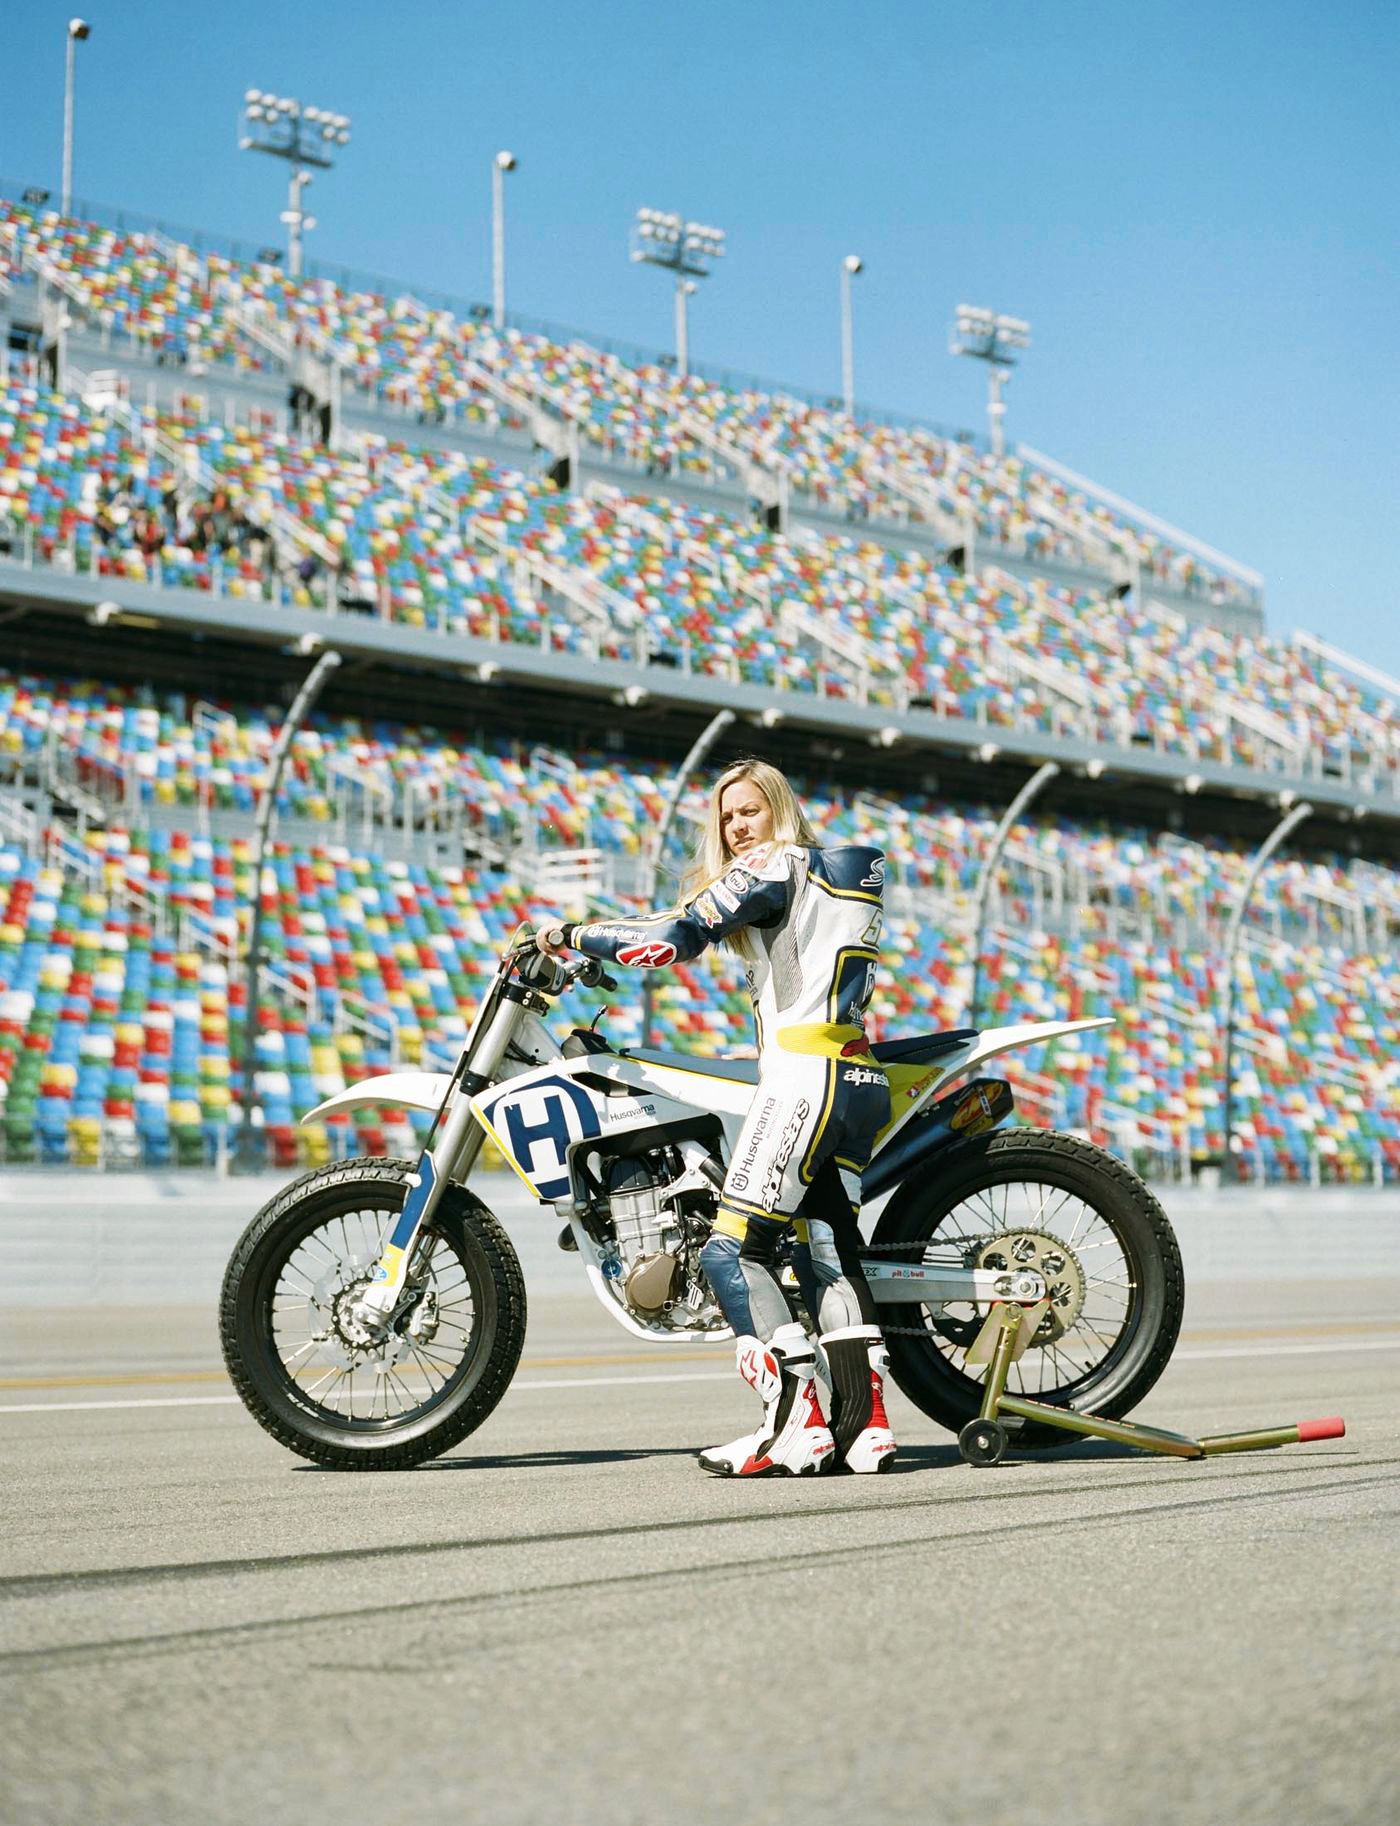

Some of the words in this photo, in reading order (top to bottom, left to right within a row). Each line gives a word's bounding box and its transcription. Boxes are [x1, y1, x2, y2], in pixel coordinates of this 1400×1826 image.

[610, 1104, 655, 1121] Husqvarna
[739, 1097, 777, 1173] Husqvarna
[761, 1098, 810, 1214] alpinestars
